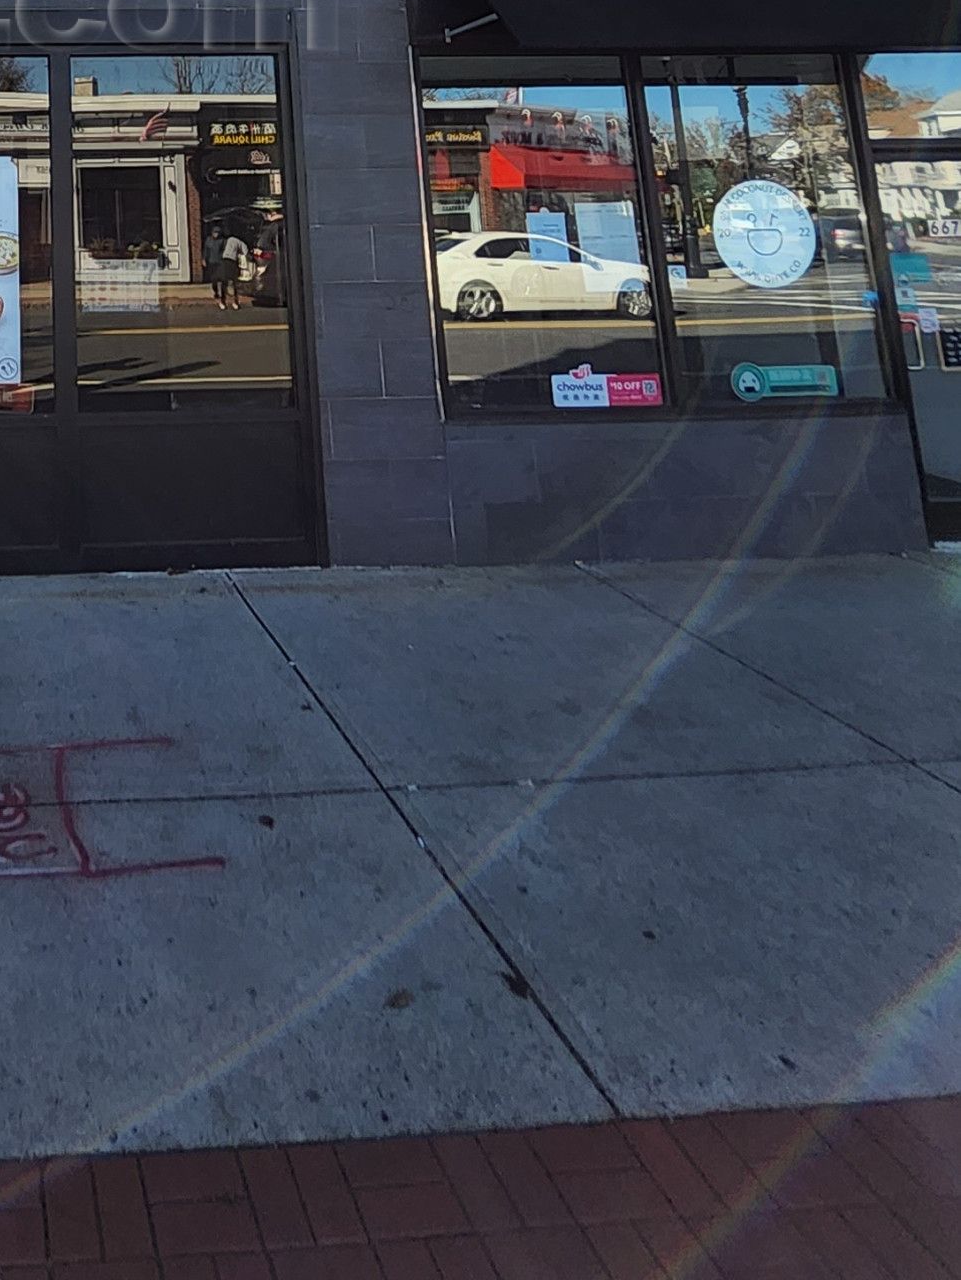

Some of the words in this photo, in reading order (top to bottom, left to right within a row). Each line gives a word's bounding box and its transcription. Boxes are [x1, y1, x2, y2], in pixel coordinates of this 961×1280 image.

[799, 227, 811, 237] 22
[931, 221, 958, 235] 667
[557, 381, 604, 392] chowbus
[624, 381, 640, 390] OFF
